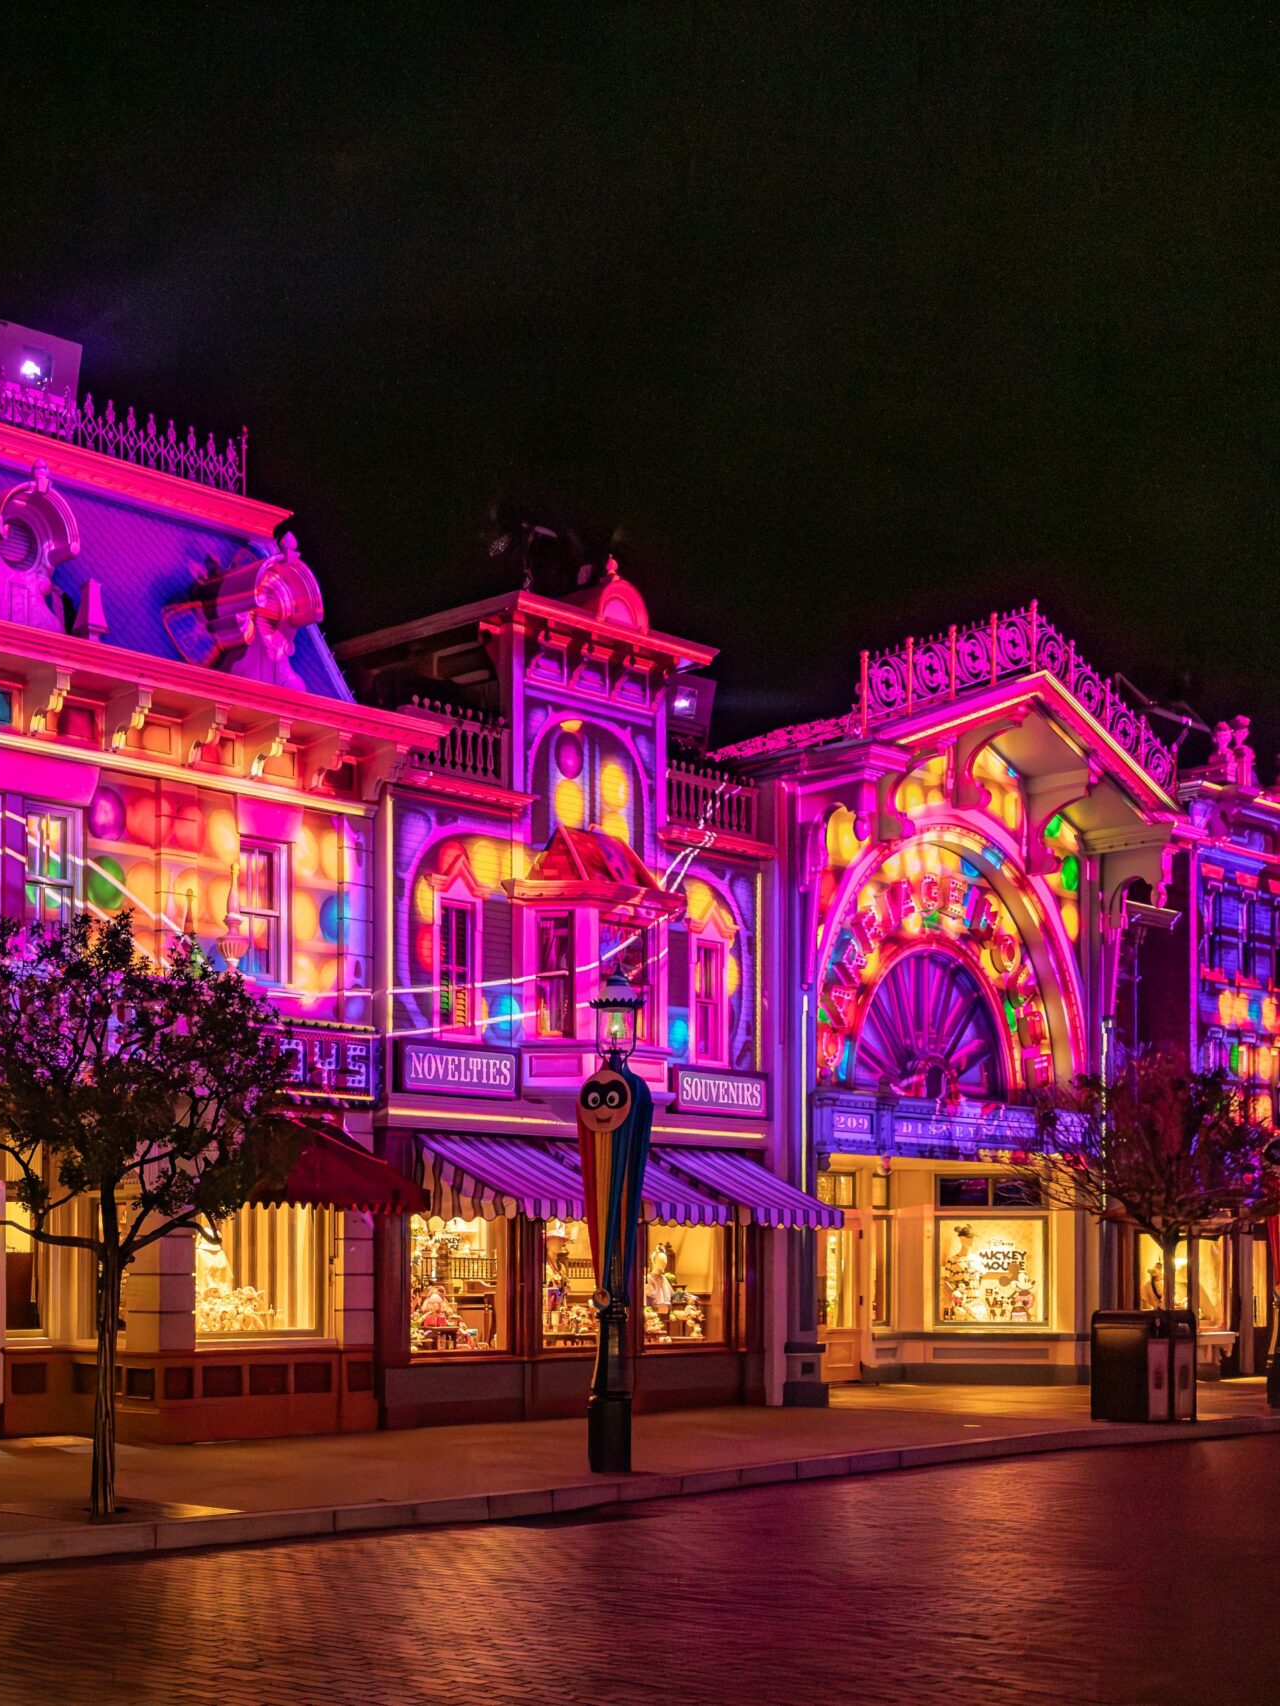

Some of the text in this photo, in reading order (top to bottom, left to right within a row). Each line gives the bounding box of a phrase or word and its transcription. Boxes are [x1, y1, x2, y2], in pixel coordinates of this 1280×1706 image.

[261, 1037, 367, 1088] OYS
[409, 1052, 512, 1087] NOVELTIES
[682, 1077, 762, 1108] SOUVENIRS
[835, 1115, 869, 1131] 209
[979, 1250, 1028, 1261] MICKEY
